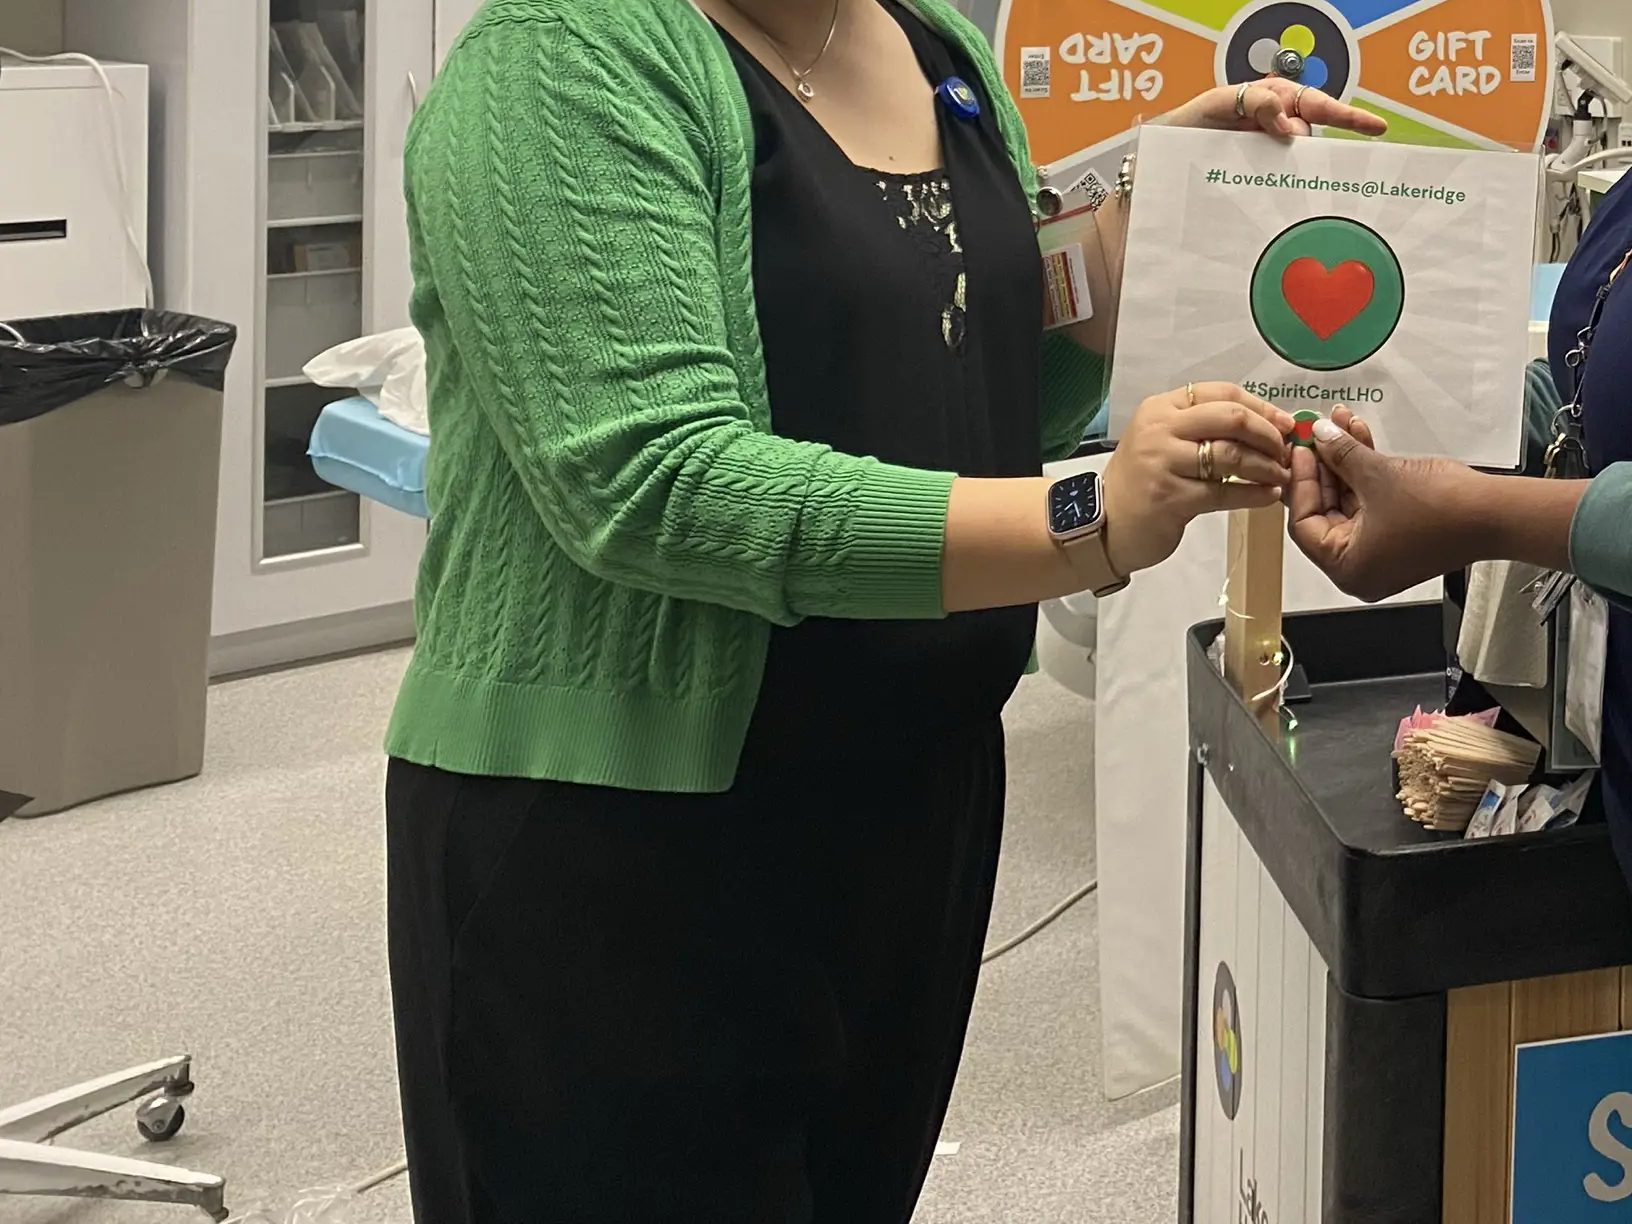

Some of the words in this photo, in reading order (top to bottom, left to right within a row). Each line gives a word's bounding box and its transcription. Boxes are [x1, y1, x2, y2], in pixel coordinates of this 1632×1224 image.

[1058, 32, 1164, 64] CARD
[1408, 30, 1490, 61] GIFT
[1071, 68, 1163, 102] GIFT
[1408, 64, 1501, 95] CARD
[1205, 168, 1467, 205] #Love&Kindness@Lakeridge
[1242, 380, 1384, 403] #SpiritCartLHO
